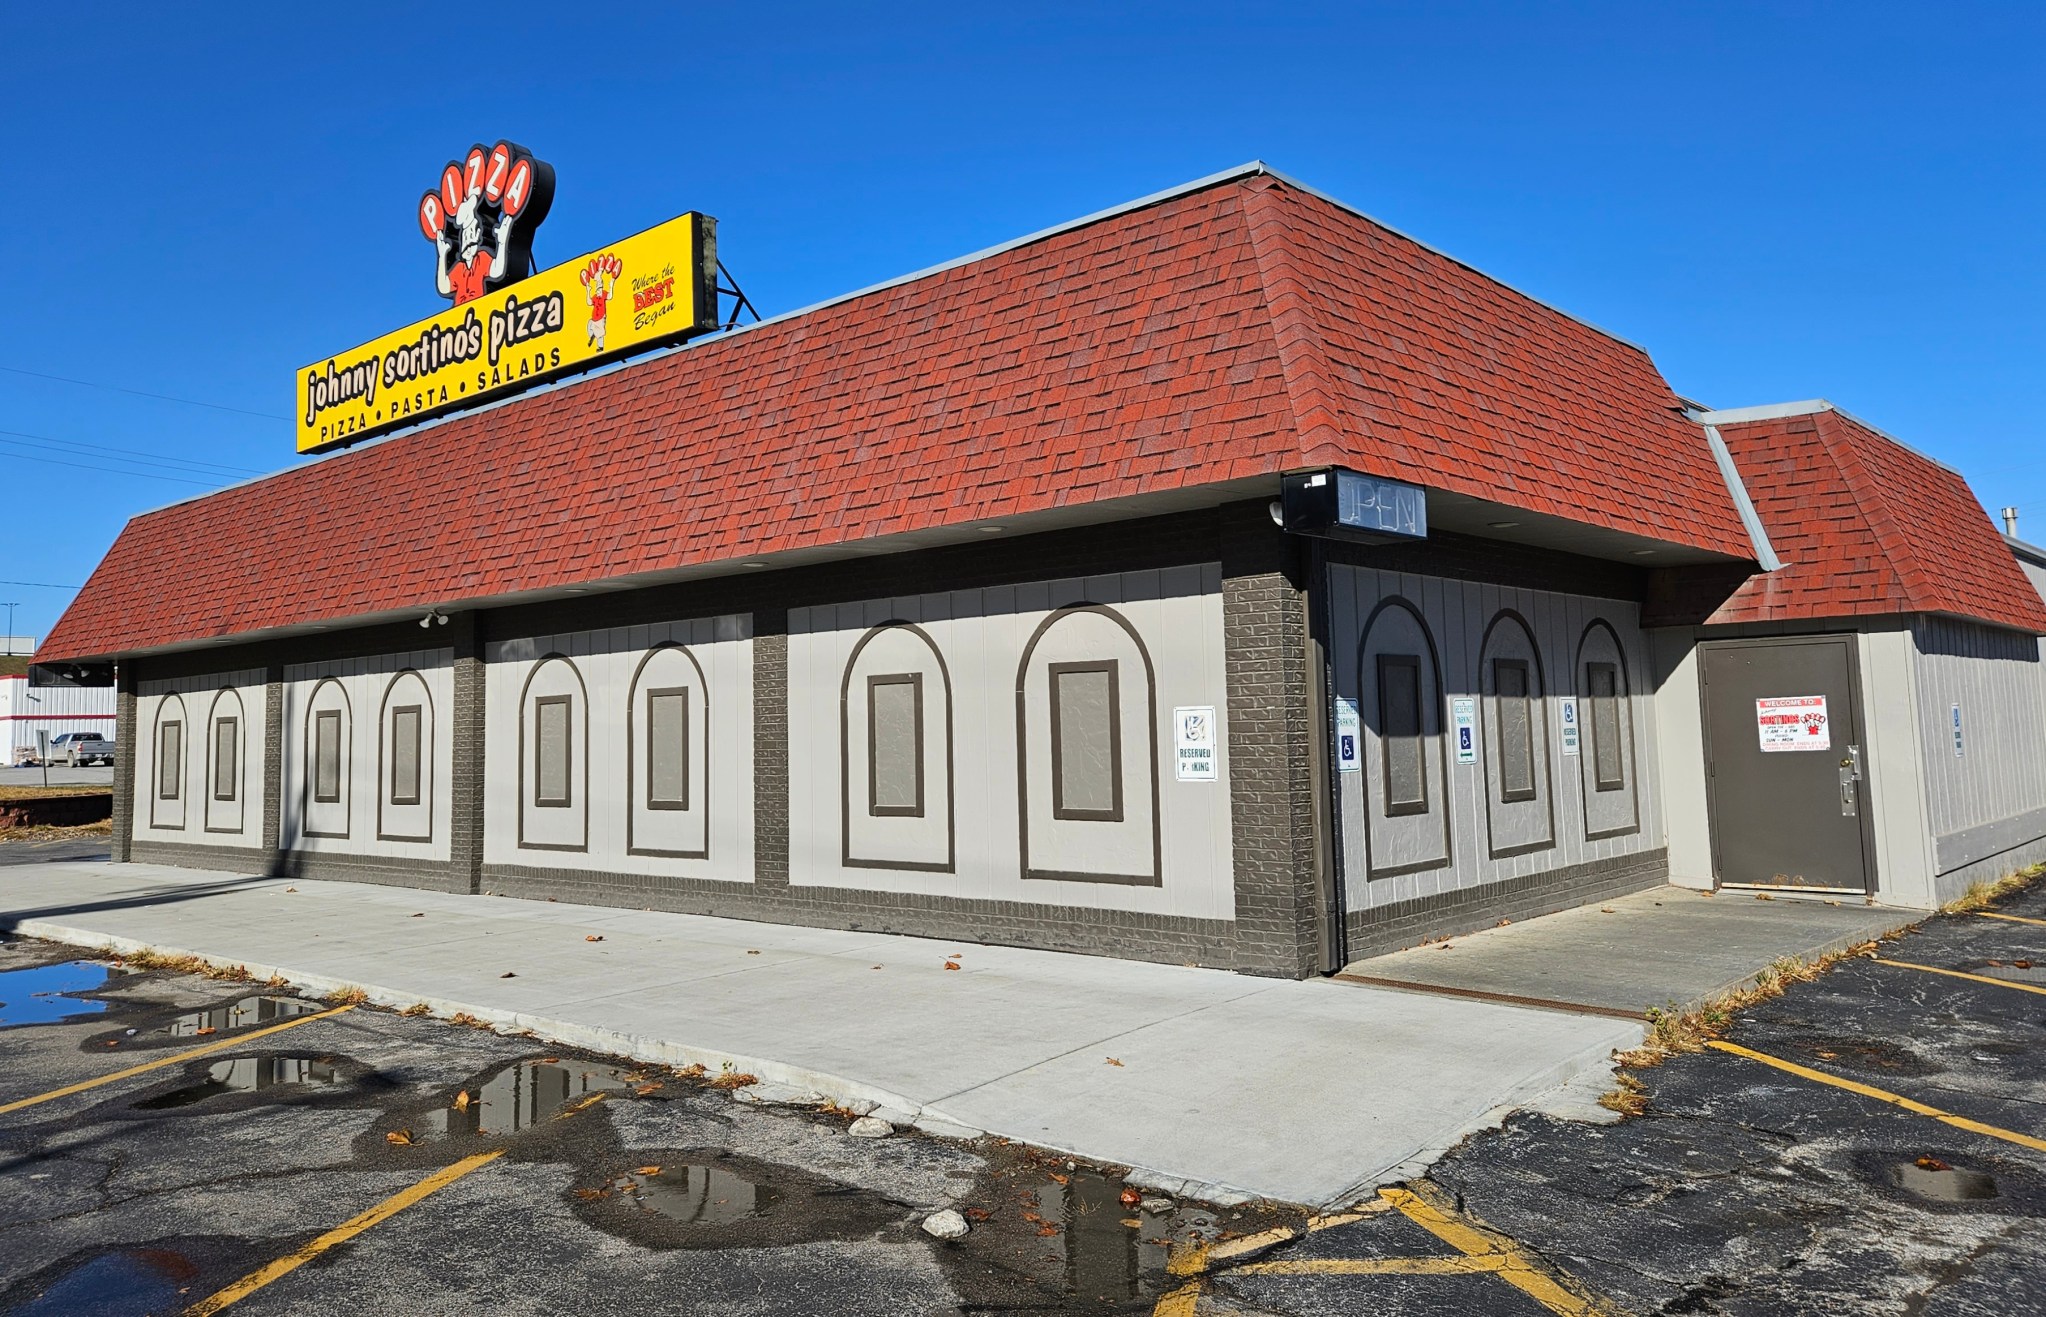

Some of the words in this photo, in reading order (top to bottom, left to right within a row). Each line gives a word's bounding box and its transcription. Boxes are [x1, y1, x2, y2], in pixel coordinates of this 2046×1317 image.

[423, 151, 527, 233] PIZZA
[582, 254, 621, 283] PIZZA
[631, 273, 659, 292] Where
[661, 262, 675, 279] the
[633, 276, 675, 313] BEST
[633, 301, 676, 330] Began
[306, 361, 379, 427] johnny
[383, 309, 482, 388] sortino's
[489, 292, 563, 366] pizza
[321, 413, 366, 442] PIZZA
[390, 384, 448, 418] PASTA
[478, 347, 560, 390] SALADS
[1179, 748, 1211, 758] RESERVED
